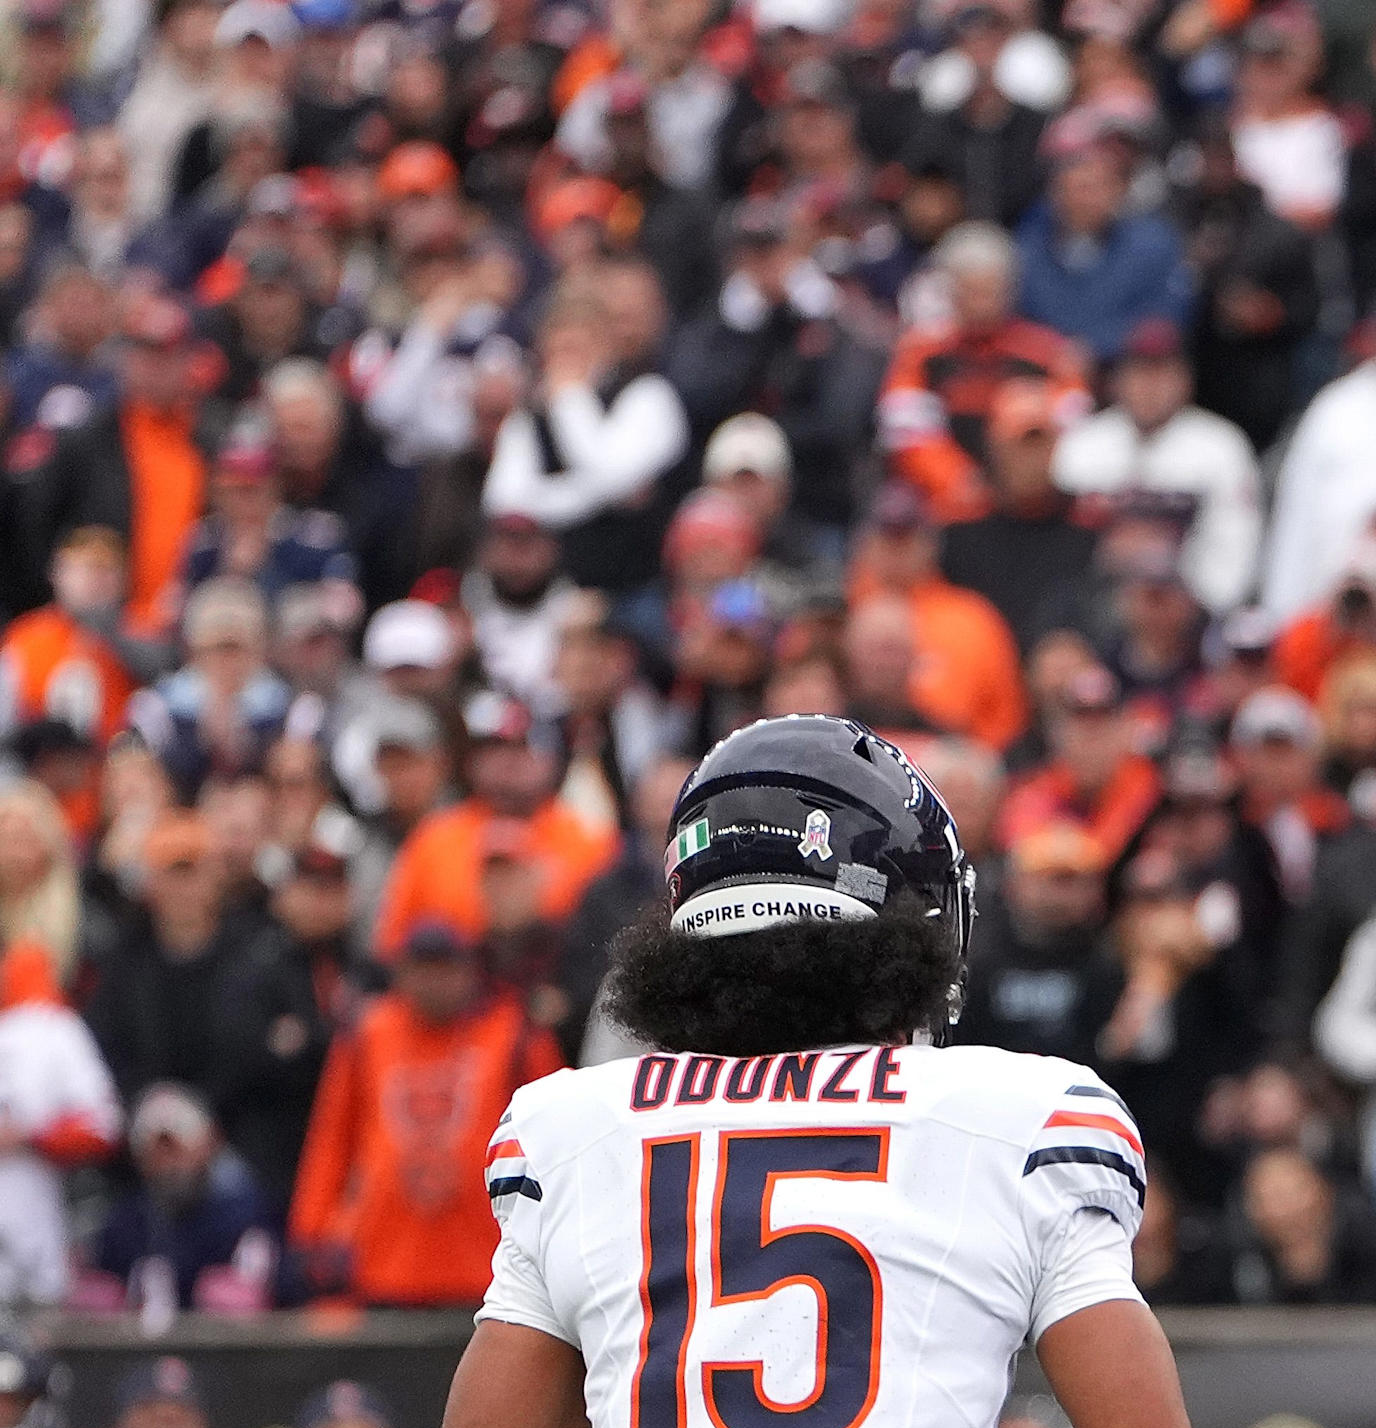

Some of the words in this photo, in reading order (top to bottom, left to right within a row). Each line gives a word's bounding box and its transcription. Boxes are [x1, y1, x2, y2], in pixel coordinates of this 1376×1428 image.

[682, 904, 745, 933] INSPIRE
[752, 902, 842, 919] CHANGE
[629, 1046, 907, 1112] ODUNZE
